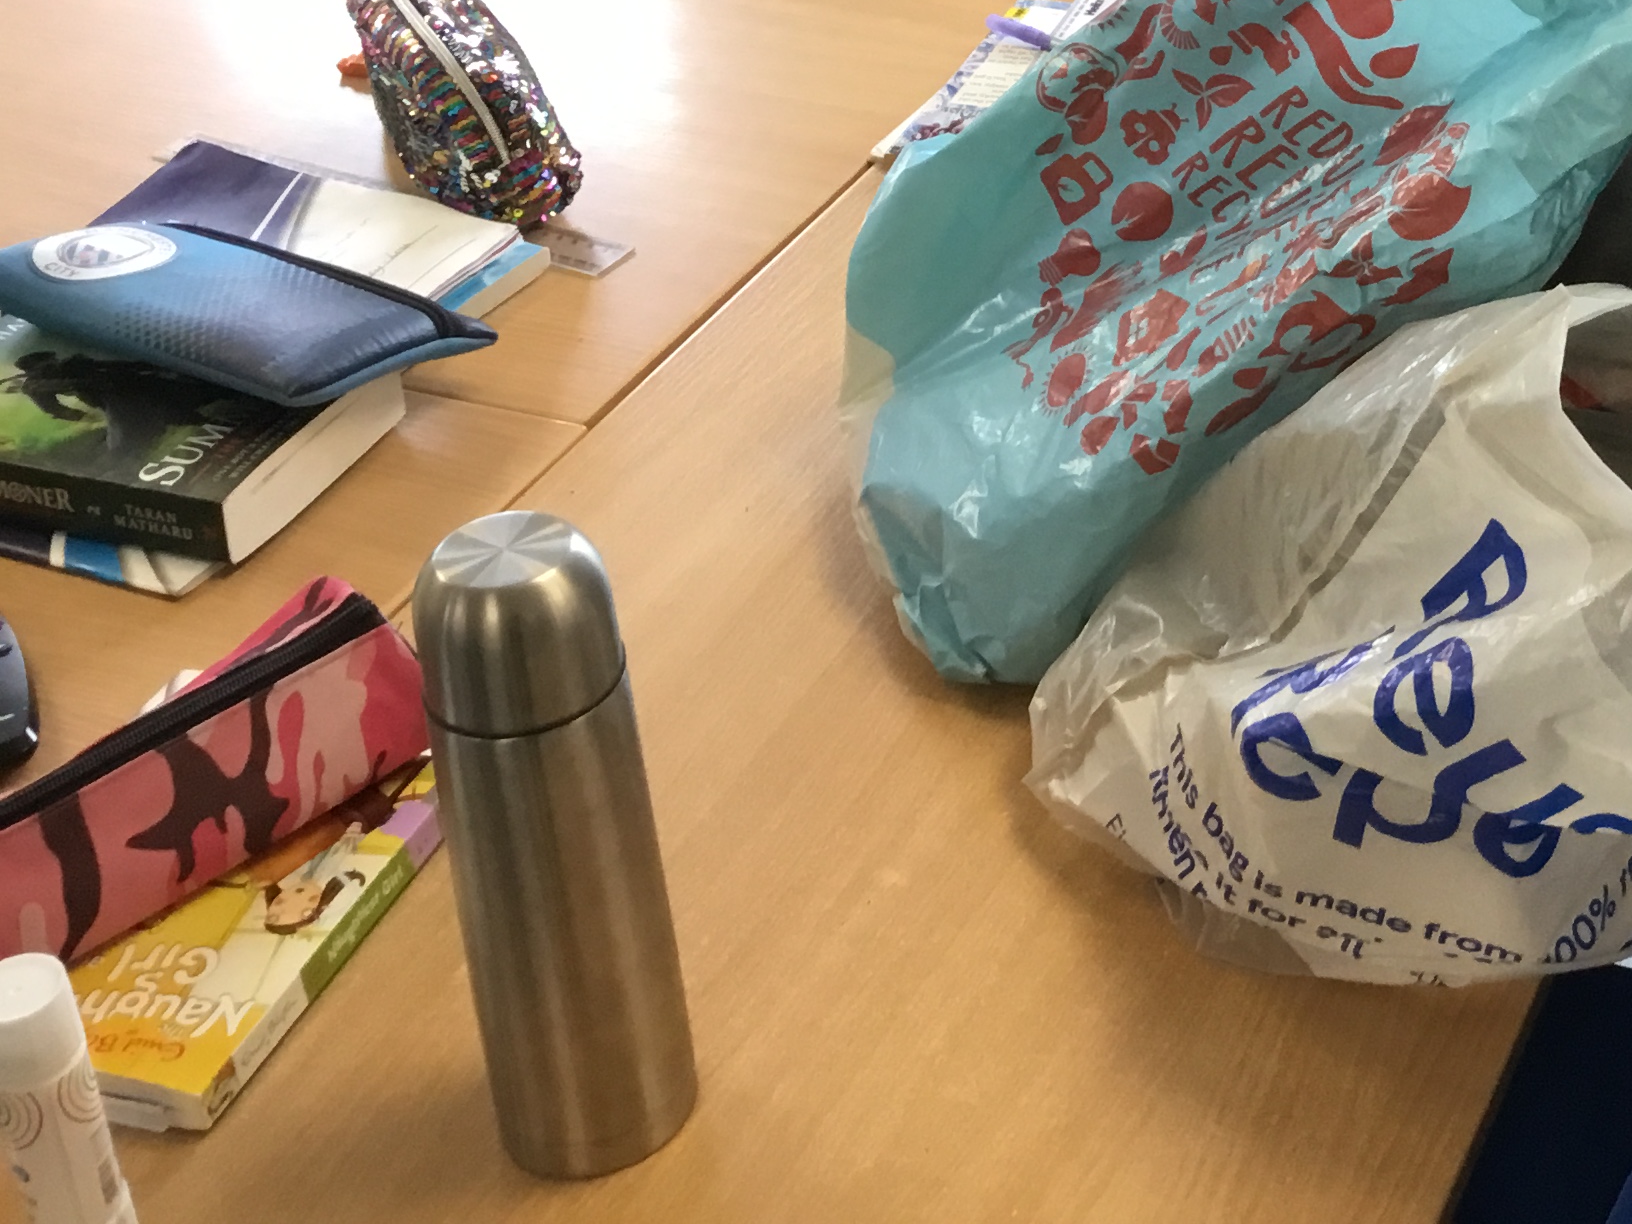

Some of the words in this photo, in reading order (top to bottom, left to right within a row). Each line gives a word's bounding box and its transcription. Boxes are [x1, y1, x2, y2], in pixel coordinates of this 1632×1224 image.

[0, 481, 75, 513] ONER
[124, 503, 178, 524] TARAN
[113, 514, 194, 540] MATHARU
[1170, 722, 1199, 810] This
[1202, 801, 1250, 883] bag
[1253, 869, 1284, 898] is
[1295, 890, 1413, 934] made
[1424, 921, 1523, 964] from
[1544, 884, 1617, 965] 00%
[106, 942, 219, 985] Girl
[78, 971, 255, 1039] Naugh
